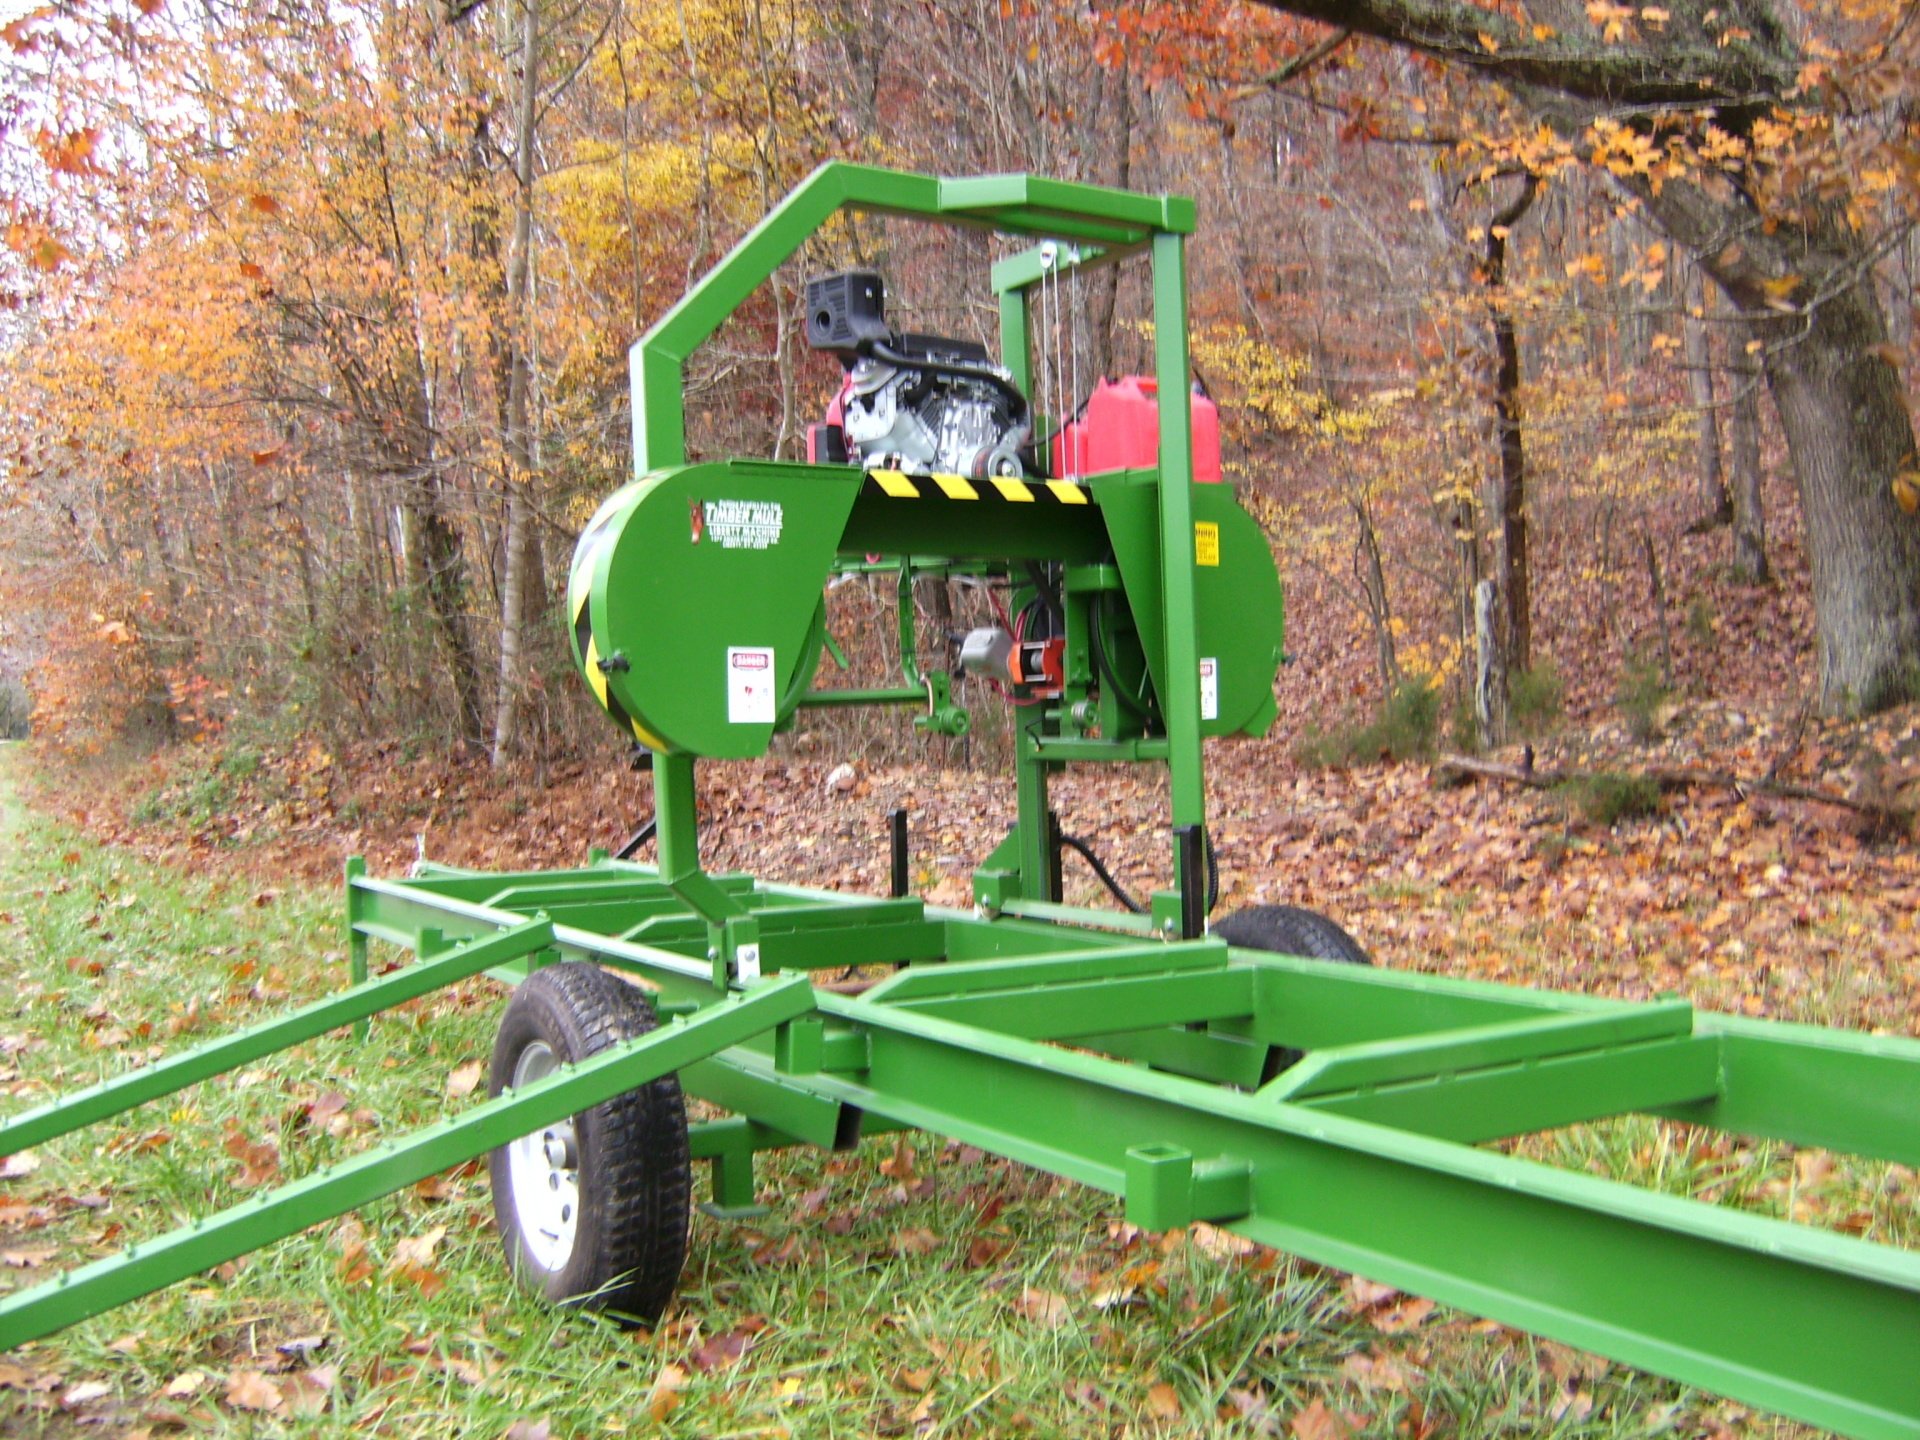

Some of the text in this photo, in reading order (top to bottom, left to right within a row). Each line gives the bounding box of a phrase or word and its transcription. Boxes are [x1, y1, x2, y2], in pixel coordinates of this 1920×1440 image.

[706, 504, 750, 524] TIMBER
[752, 507, 783, 526] MULE
[709, 525, 741, 537] LIBERTY
